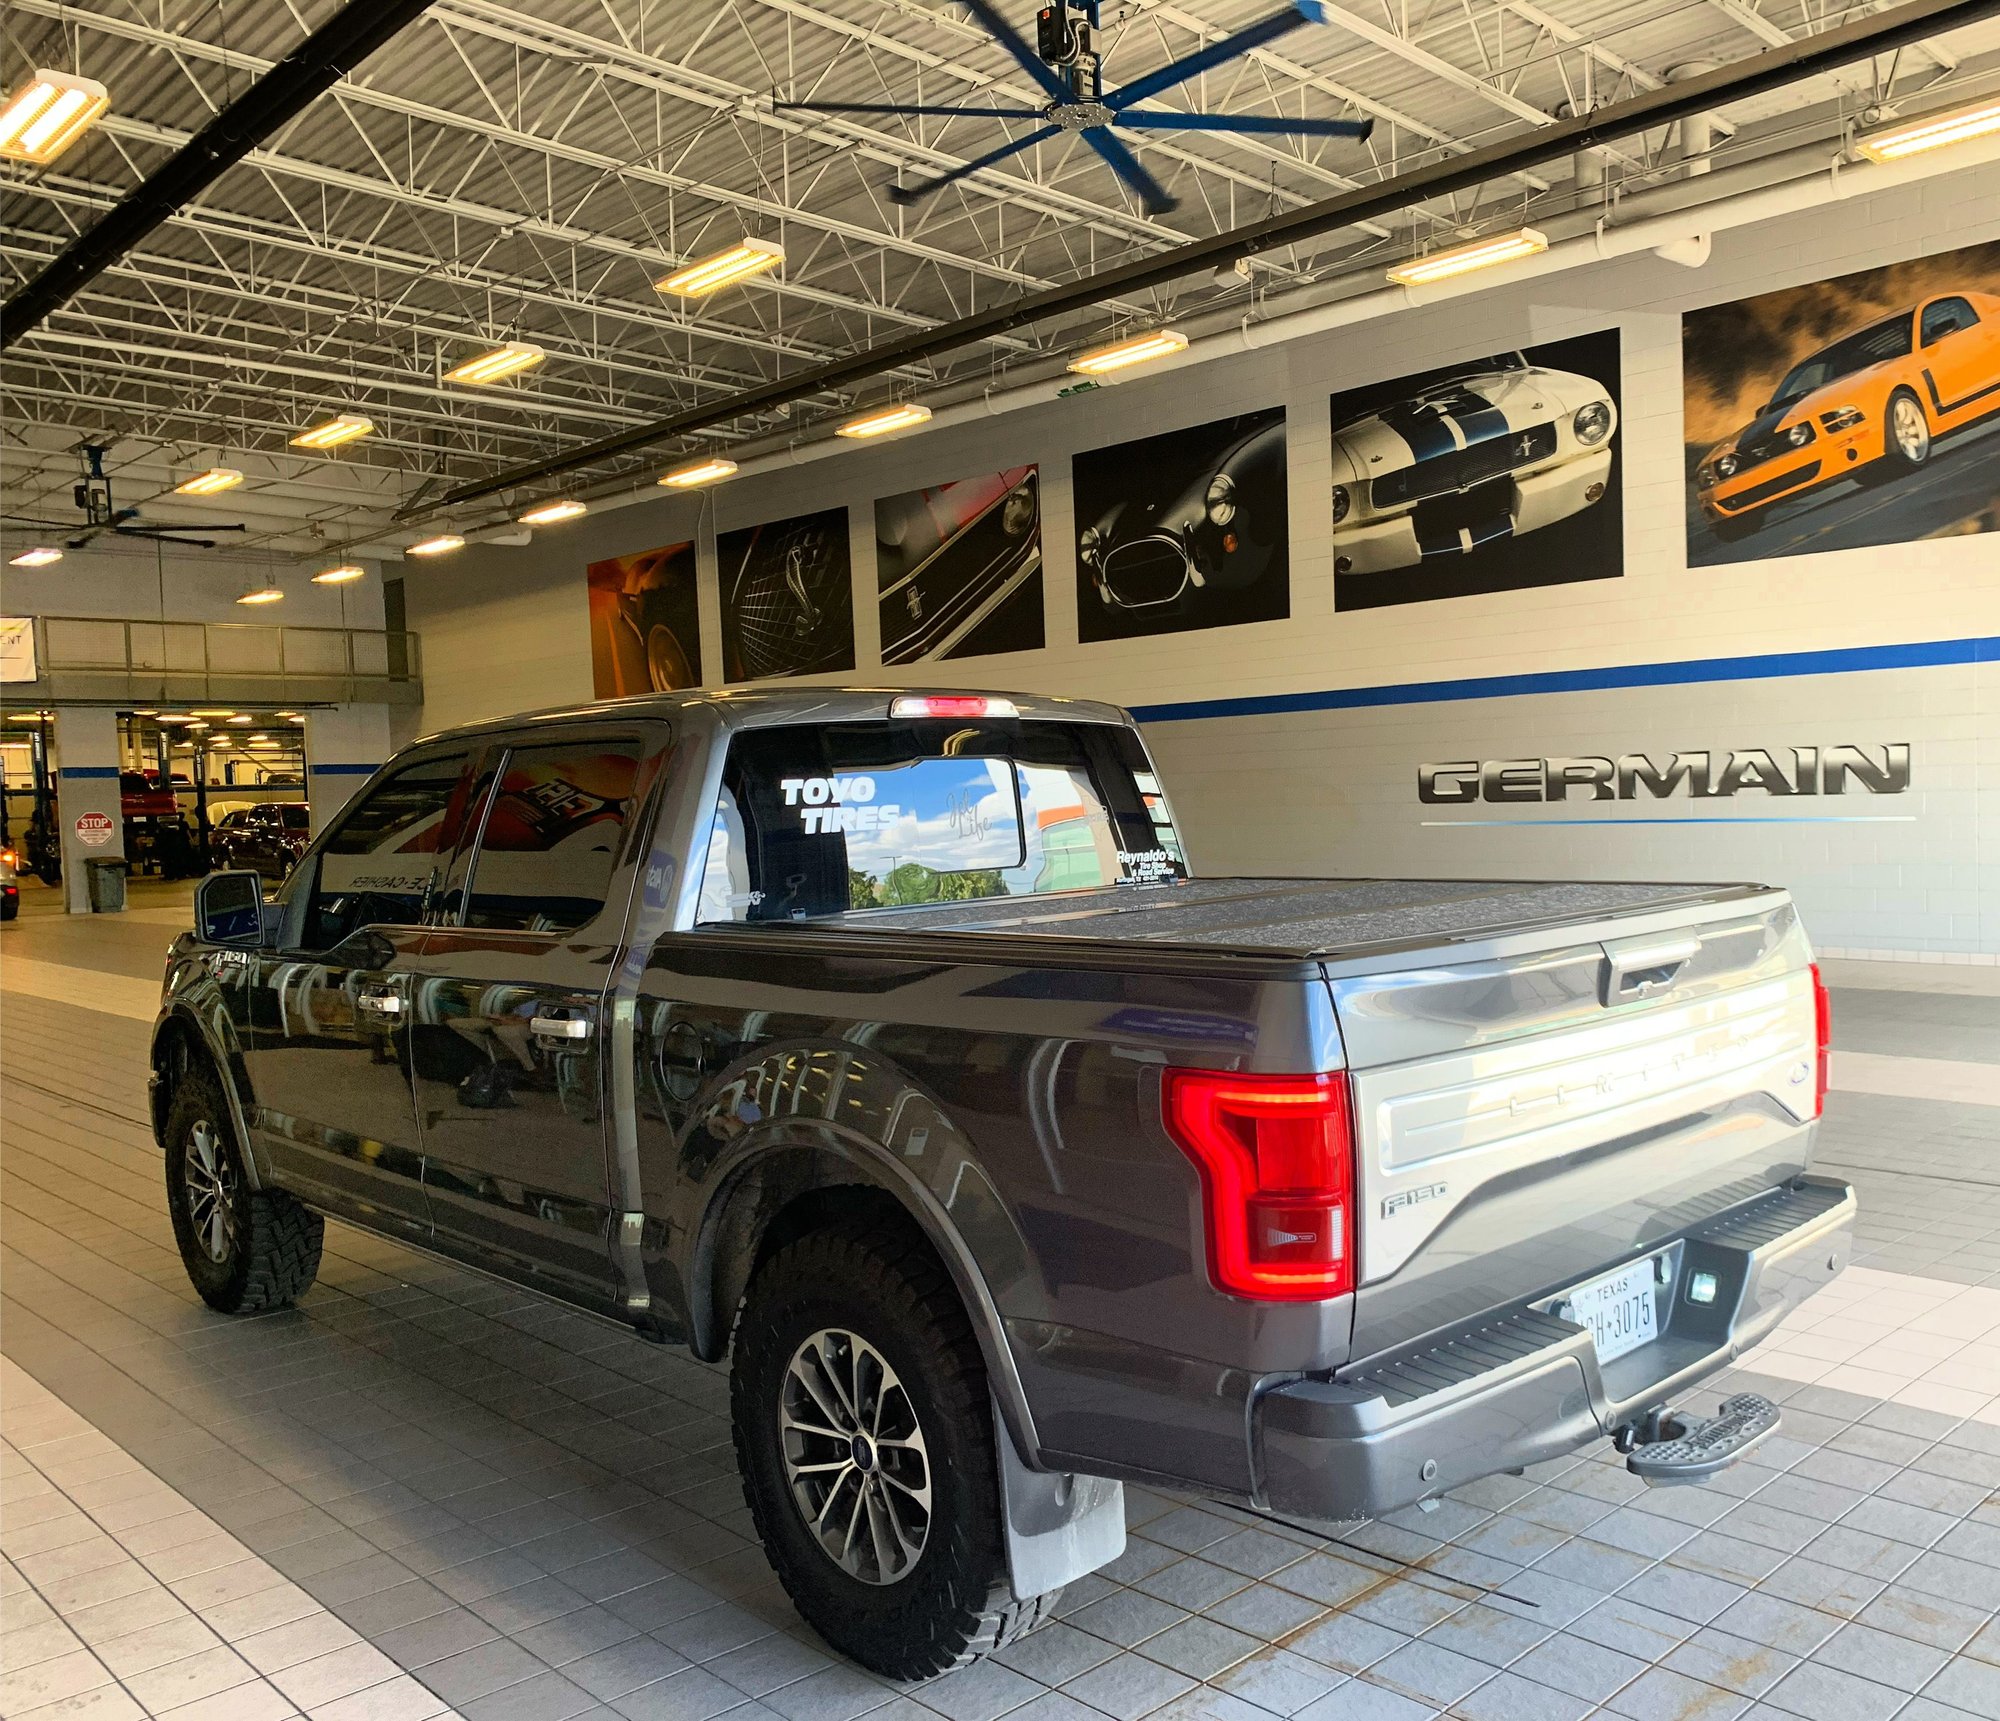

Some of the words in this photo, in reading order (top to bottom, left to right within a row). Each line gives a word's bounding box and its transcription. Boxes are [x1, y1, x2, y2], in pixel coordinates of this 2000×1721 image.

[1418, 743, 1910, 804] GERMAIN
[781, 776, 875, 806] TOYO
[81, 818, 108, 828] STOP
[801, 804, 900, 835] TIRES
[1116, 849, 1175, 866] Reynaldo's
[1151, 862, 1167, 870] Shop
[1154, 867, 1175, 875] Service
[1597, 1277, 1628, 1302] TEXAS
